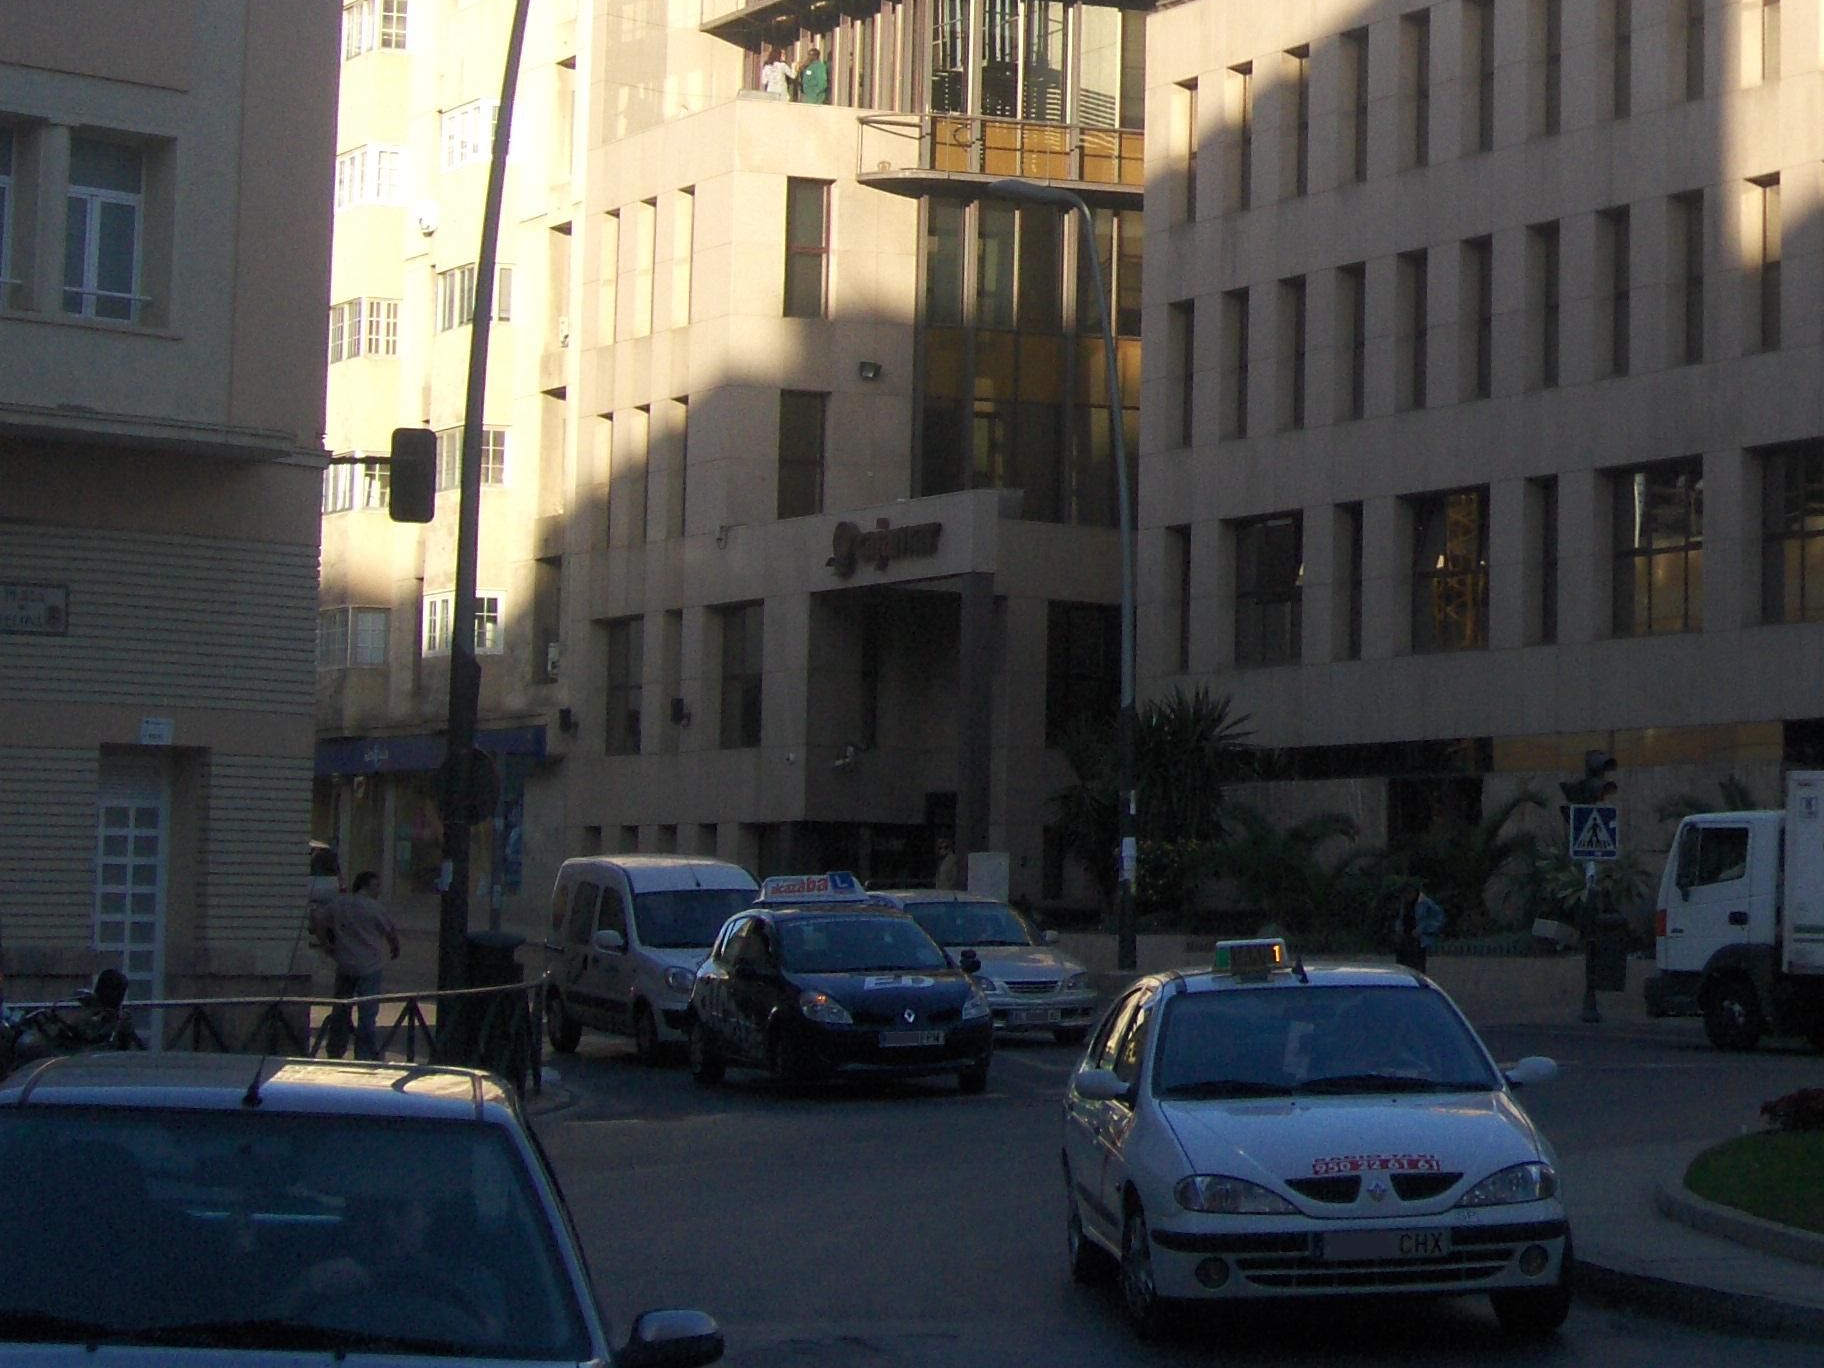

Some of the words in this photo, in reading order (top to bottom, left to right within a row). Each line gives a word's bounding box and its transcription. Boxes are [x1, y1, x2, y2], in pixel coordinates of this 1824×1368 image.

[771, 877, 829, 895] alcazaba
[834, 874, 849, 889] L
[1272, 943, 1281, 963] 1
[1315, 1161, 1351, 1174] 950
[1358, 1160, 1381, 1170] 22
[1388, 1160, 1409, 1170] 61
[1418, 1160, 1438, 1171] 61
[1399, 1232, 1443, 1255] CHX
